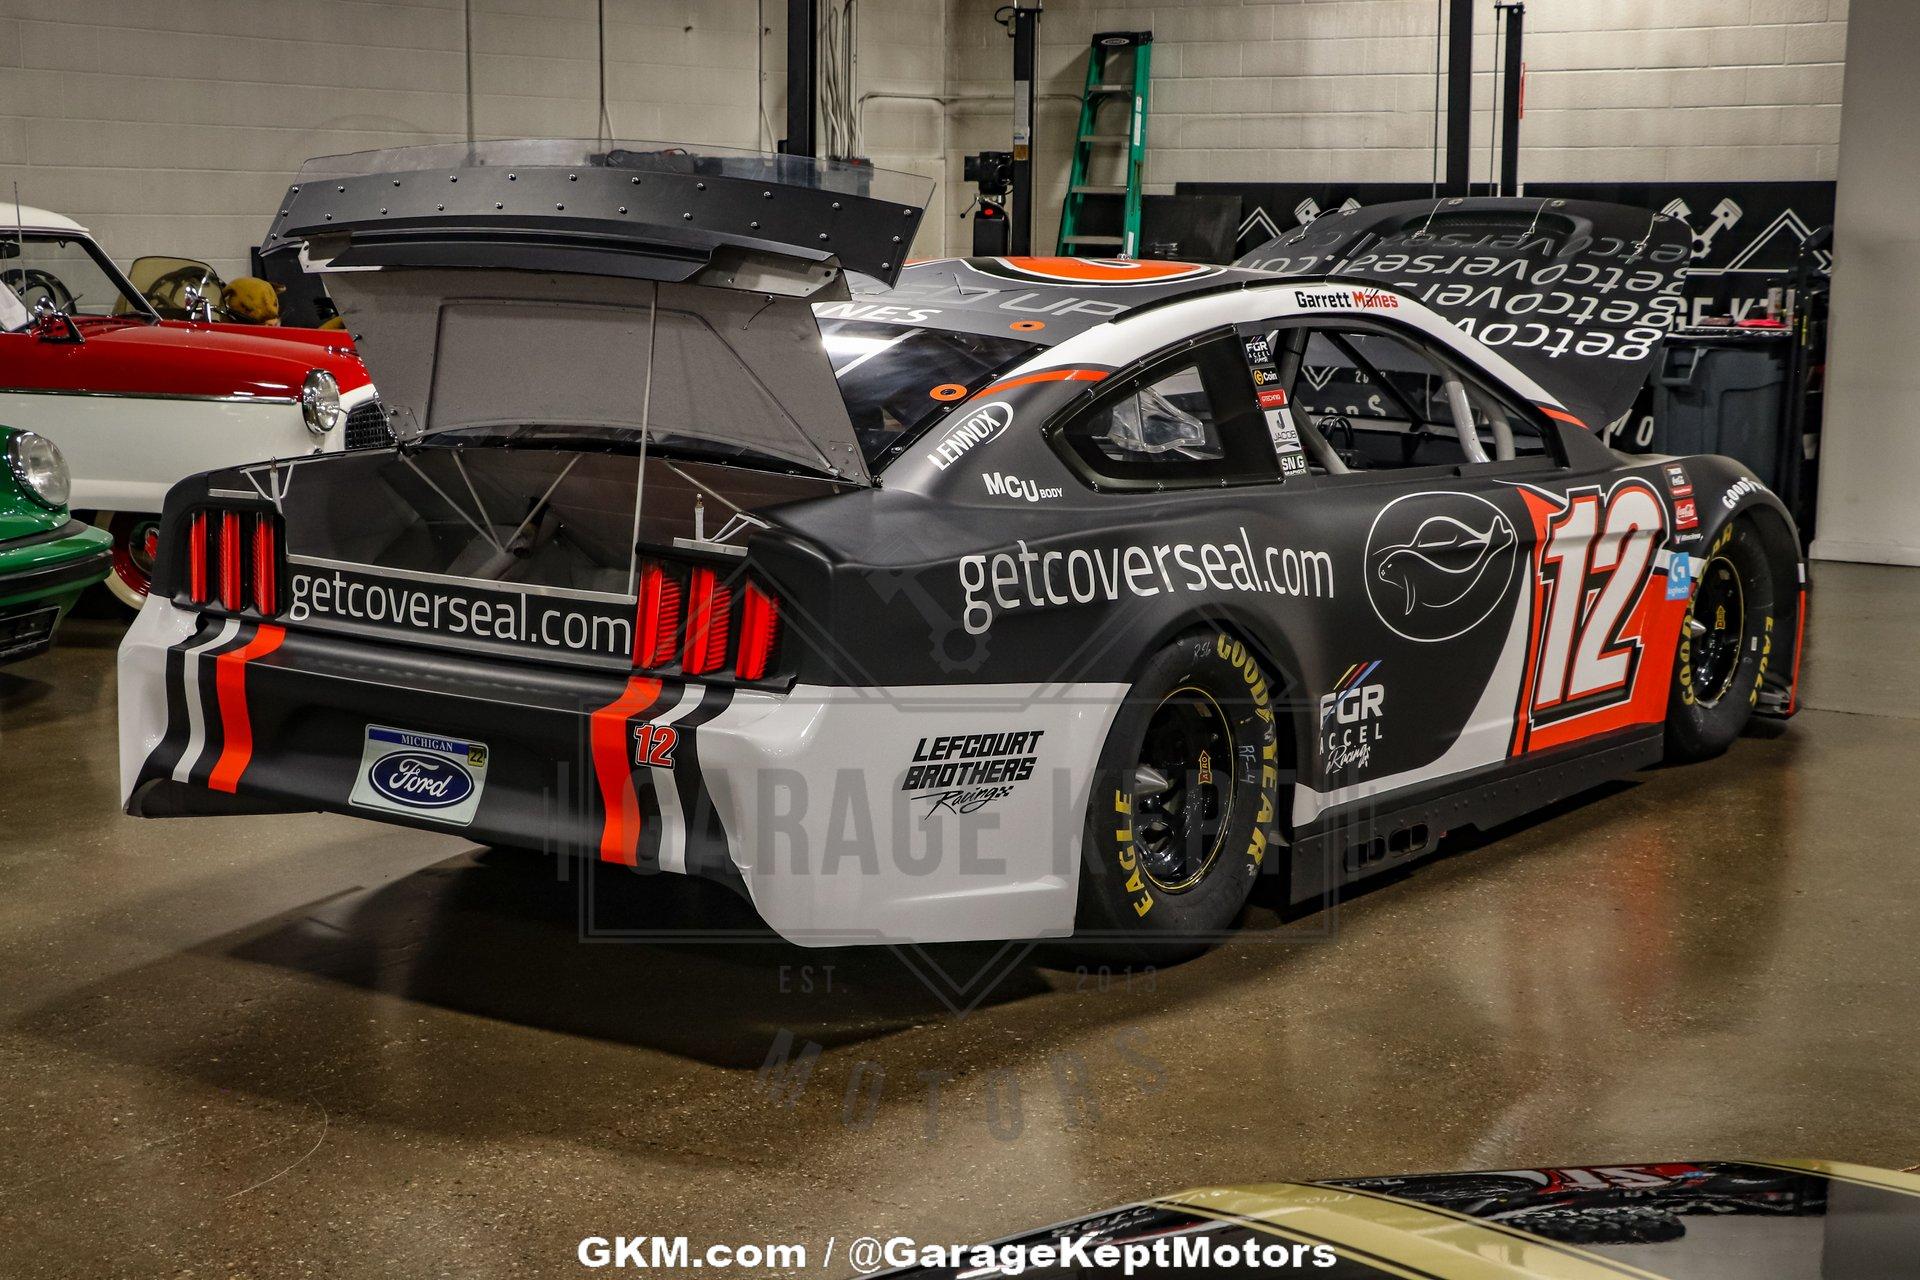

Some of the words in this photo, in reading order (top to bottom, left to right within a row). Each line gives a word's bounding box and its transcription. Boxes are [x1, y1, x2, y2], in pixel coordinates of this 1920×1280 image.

[1295, 290, 1351, 309] Garrett
[1352, 290, 1399, 309] Manes
[1392, 281, 1676, 328] getcover
[927, 410, 1001, 471] LENNOX
[1274, 431, 1298, 442] JACOB
[1039, 487, 1064, 499] BODY
[959, 527, 1334, 636] getcoverseal.com
[1532, 479, 1669, 725] 12
[290, 571, 631, 655] getcoverseal.com
[1320, 684, 1384, 730] FGR
[401, 734, 454, 752] MICHIGAN
[469, 751, 484, 764] 22
[635, 724, 678, 769] 12
[912, 730, 1045, 762] LEFCOURT
[1213, 632, 1278, 866] GOODYEAR
[389, 758, 453, 798] Ford
[902, 757, 1038, 790] BROTHERS
[1115, 789, 1154, 918] EAGLE
